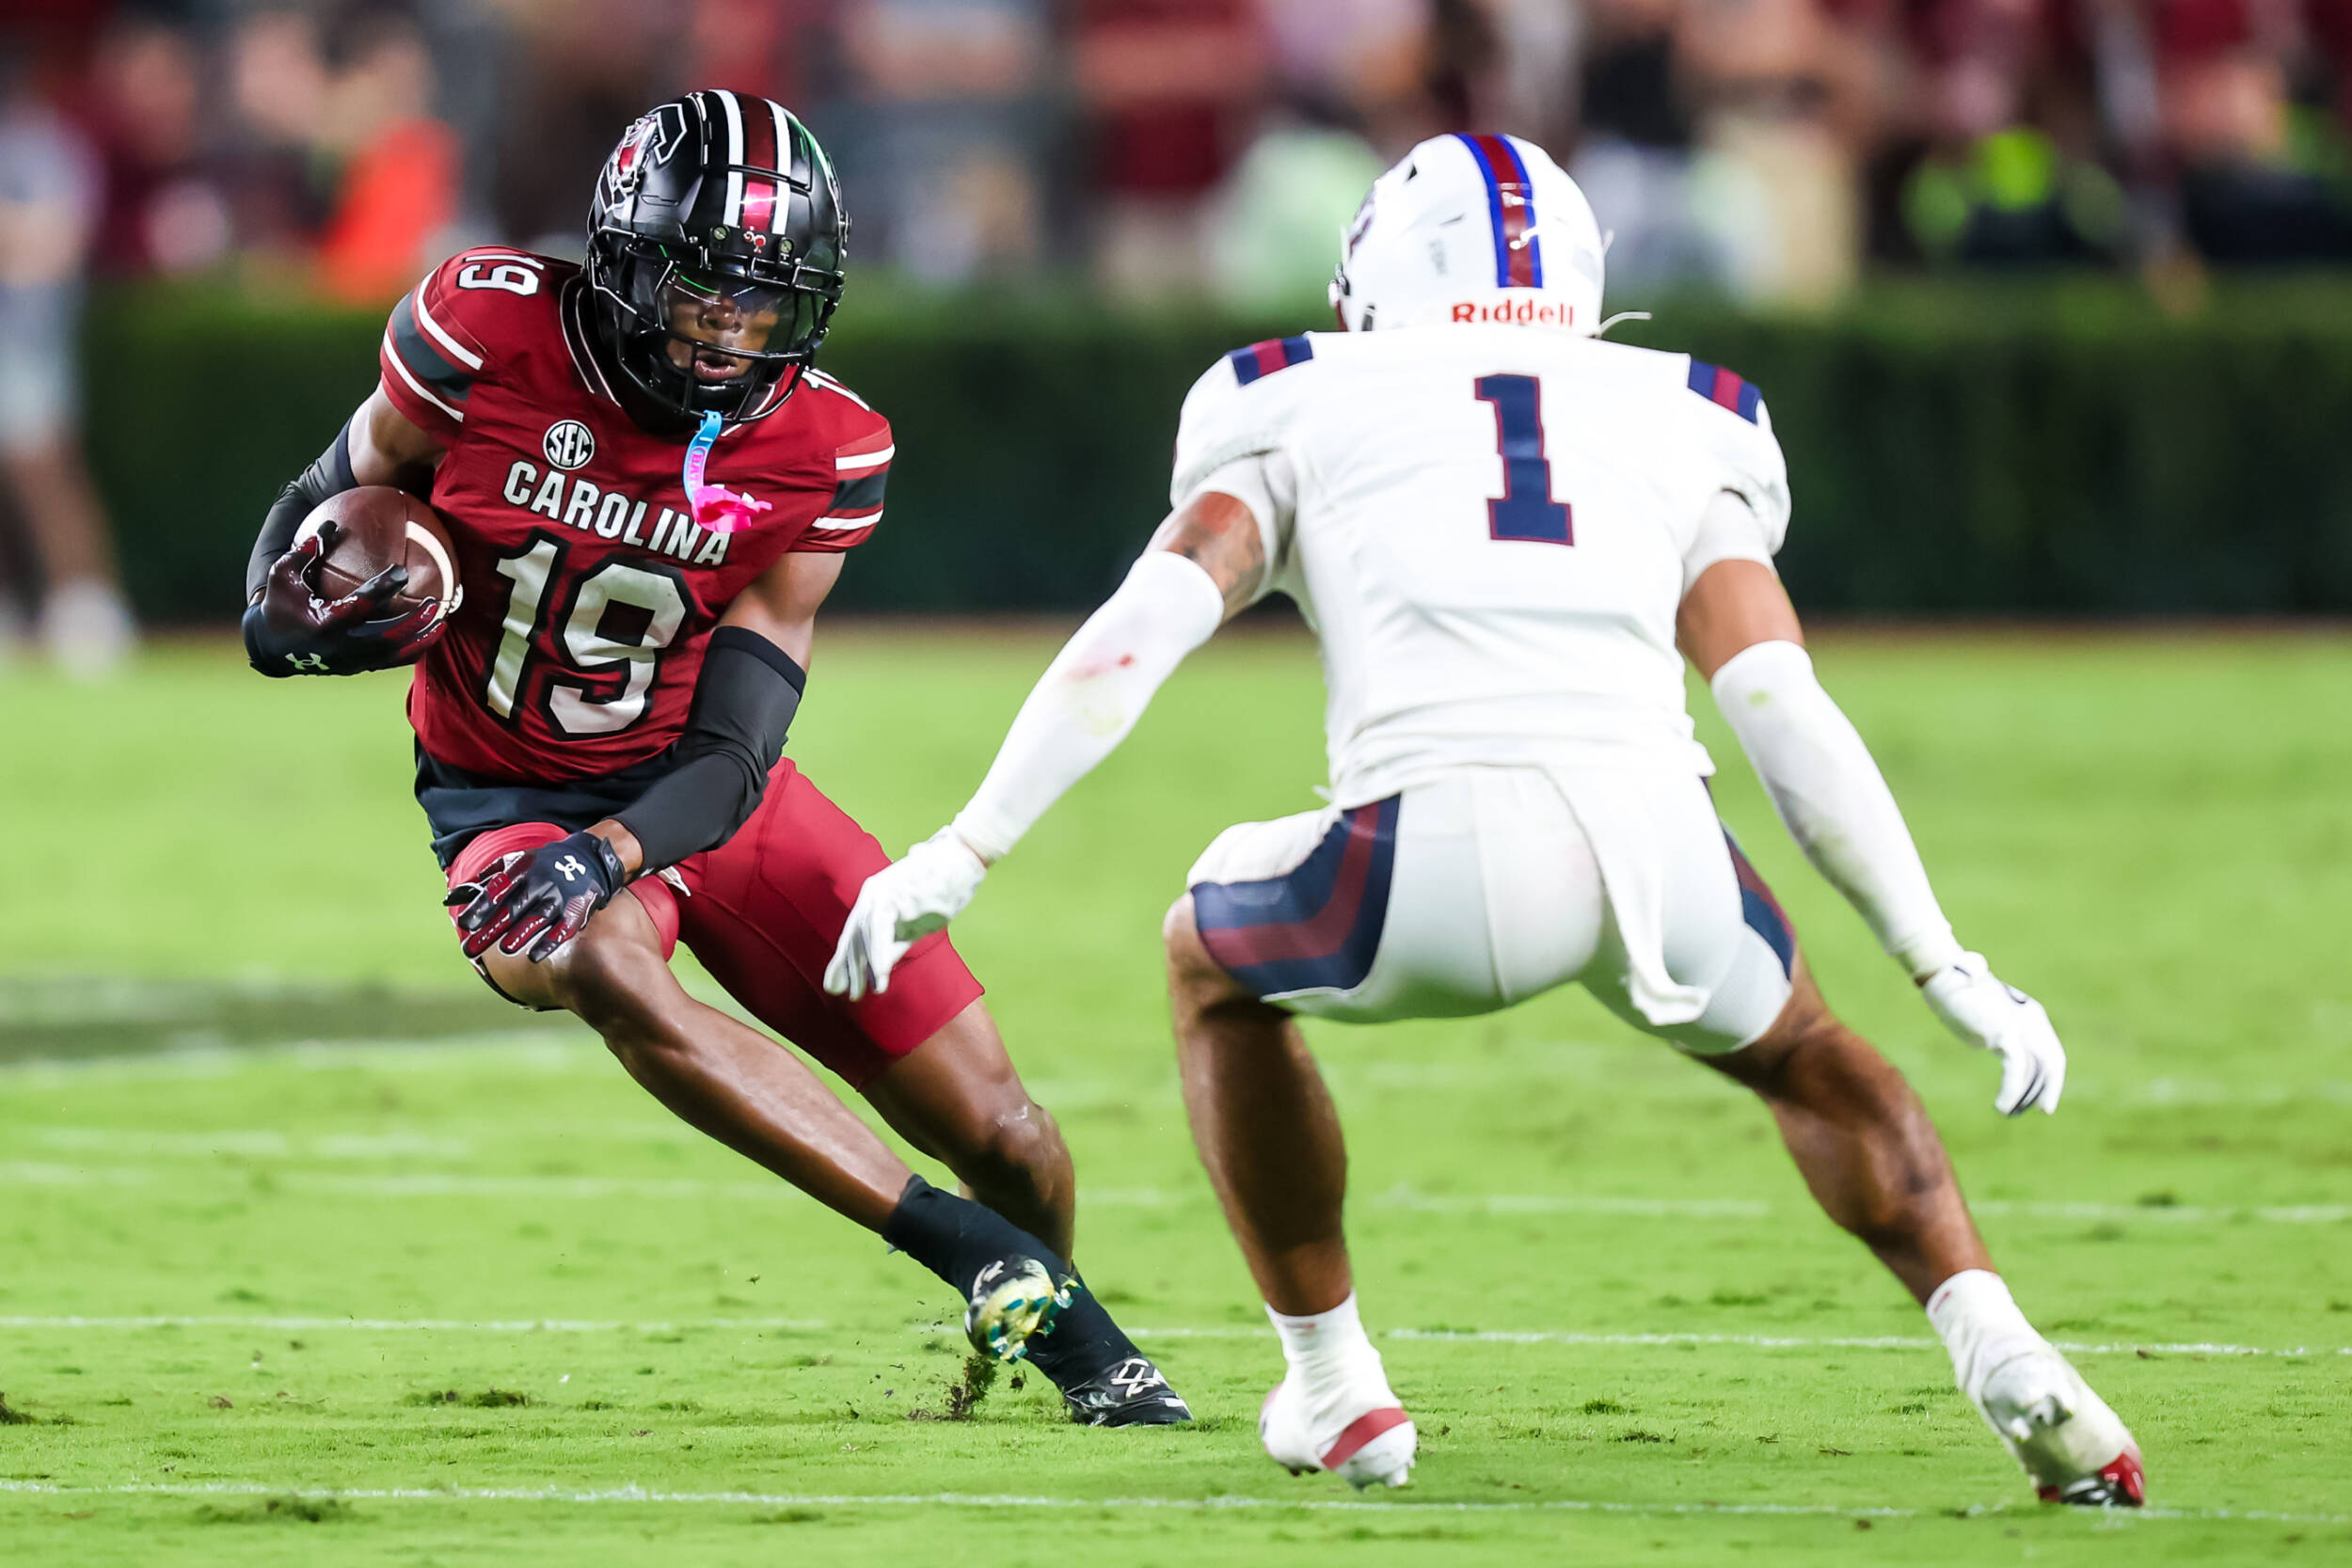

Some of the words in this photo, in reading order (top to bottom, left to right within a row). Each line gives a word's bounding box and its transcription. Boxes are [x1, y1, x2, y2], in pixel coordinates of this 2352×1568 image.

[459, 254, 545, 296] 19
[1452, 299, 1574, 327] Riddell
[547, 423, 591, 467] SEC
[1473, 372, 1575, 547] 1
[503, 460, 732, 566] CAROLINA
[486, 535, 690, 736] 19
